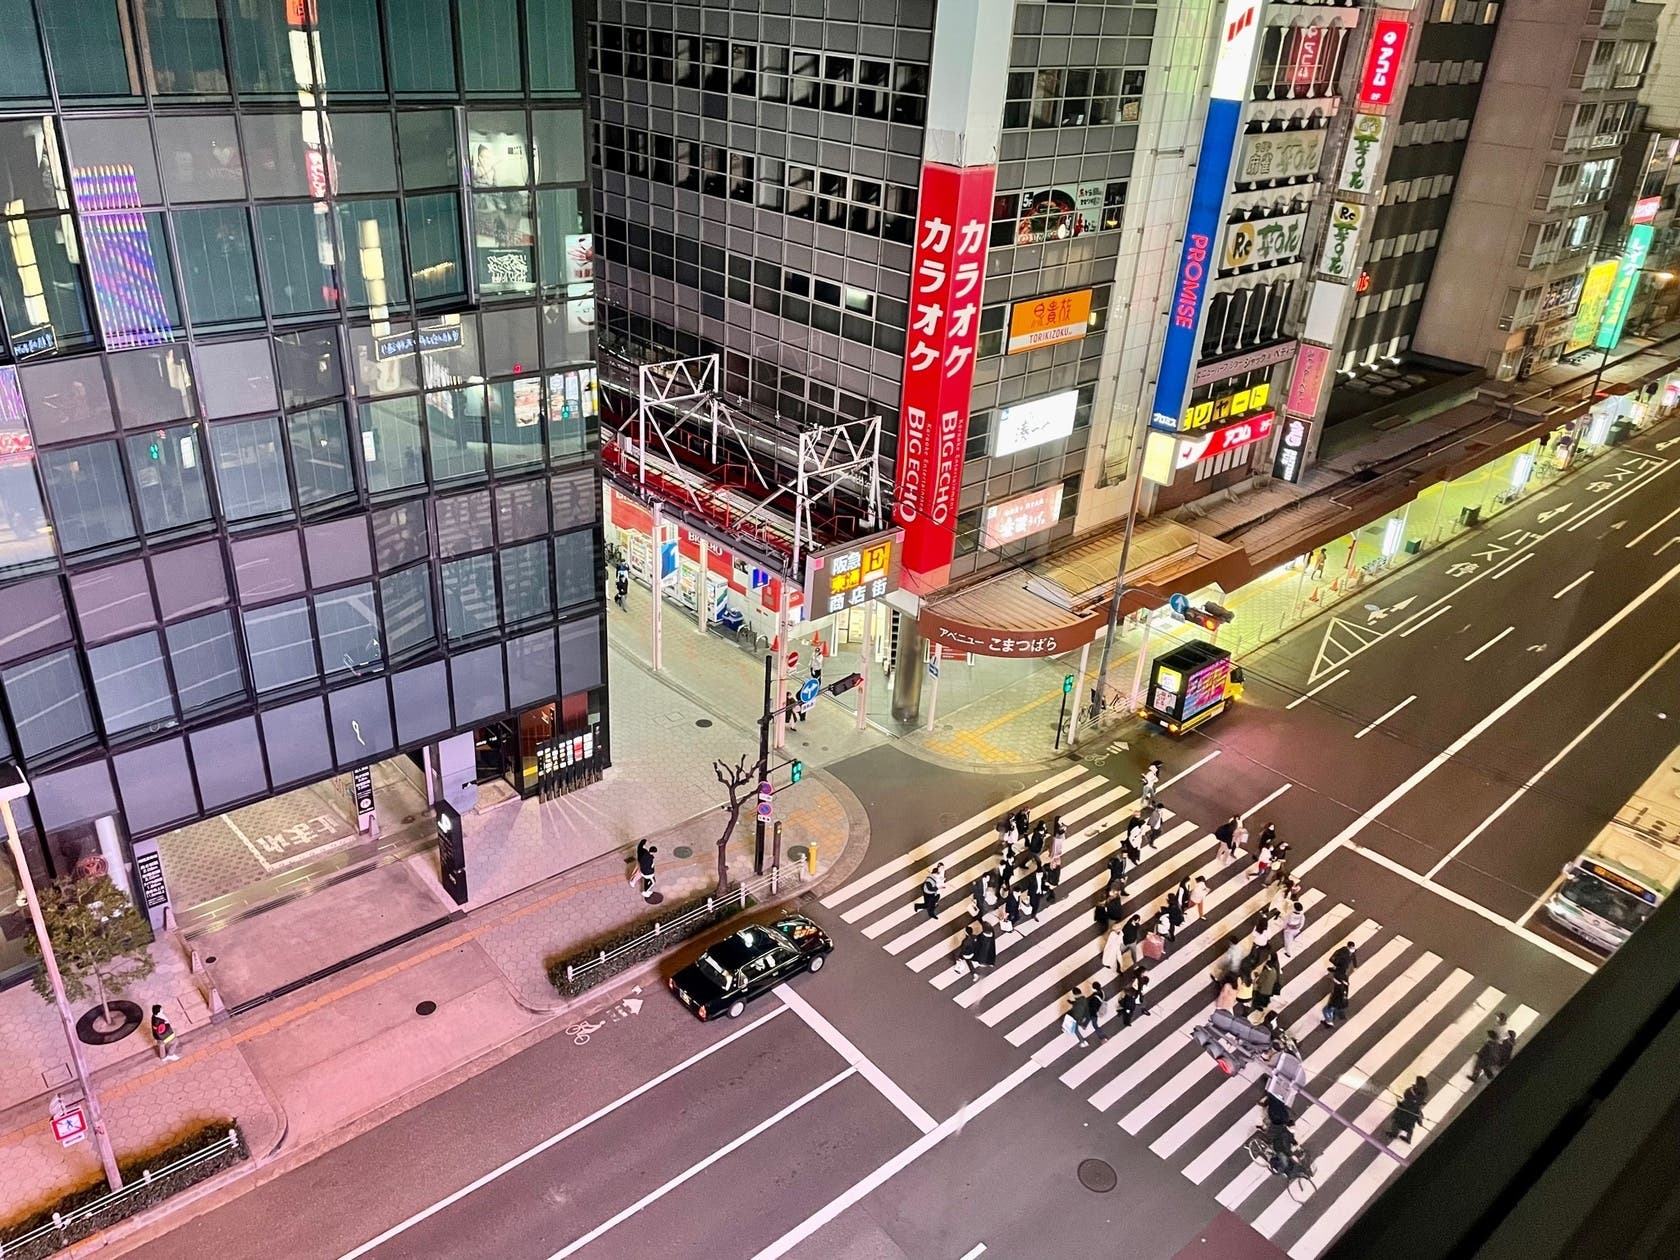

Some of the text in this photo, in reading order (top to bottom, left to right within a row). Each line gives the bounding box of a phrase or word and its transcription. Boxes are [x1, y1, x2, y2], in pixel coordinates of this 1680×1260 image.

[1372, 47, 1394, 87] アコム
[910, 217, 951, 372] カラオケ
[945, 219, 986, 378] カラオケ
[1175, 234, 1209, 330] PROMISE
[1029, 327, 1071, 344] TORIKIZOKU
[1222, 424, 1252, 448] アコム
[900, 406, 926, 523] BIG ECHO
[932, 411, 959, 526] BIG ECHO
[1584, 457, 1662, 493] バス停
[831, 551, 862, 577] 阪急
[867, 545, 886, 571] E
[1445, 529, 1543, 578] バス停
[829, 577, 888, 613] 商店街
[830, 568, 862, 595] 東通
[938, 627, 1058, 653] アベニュー こまつばら
[256, 813, 341, 854] 止まれ
